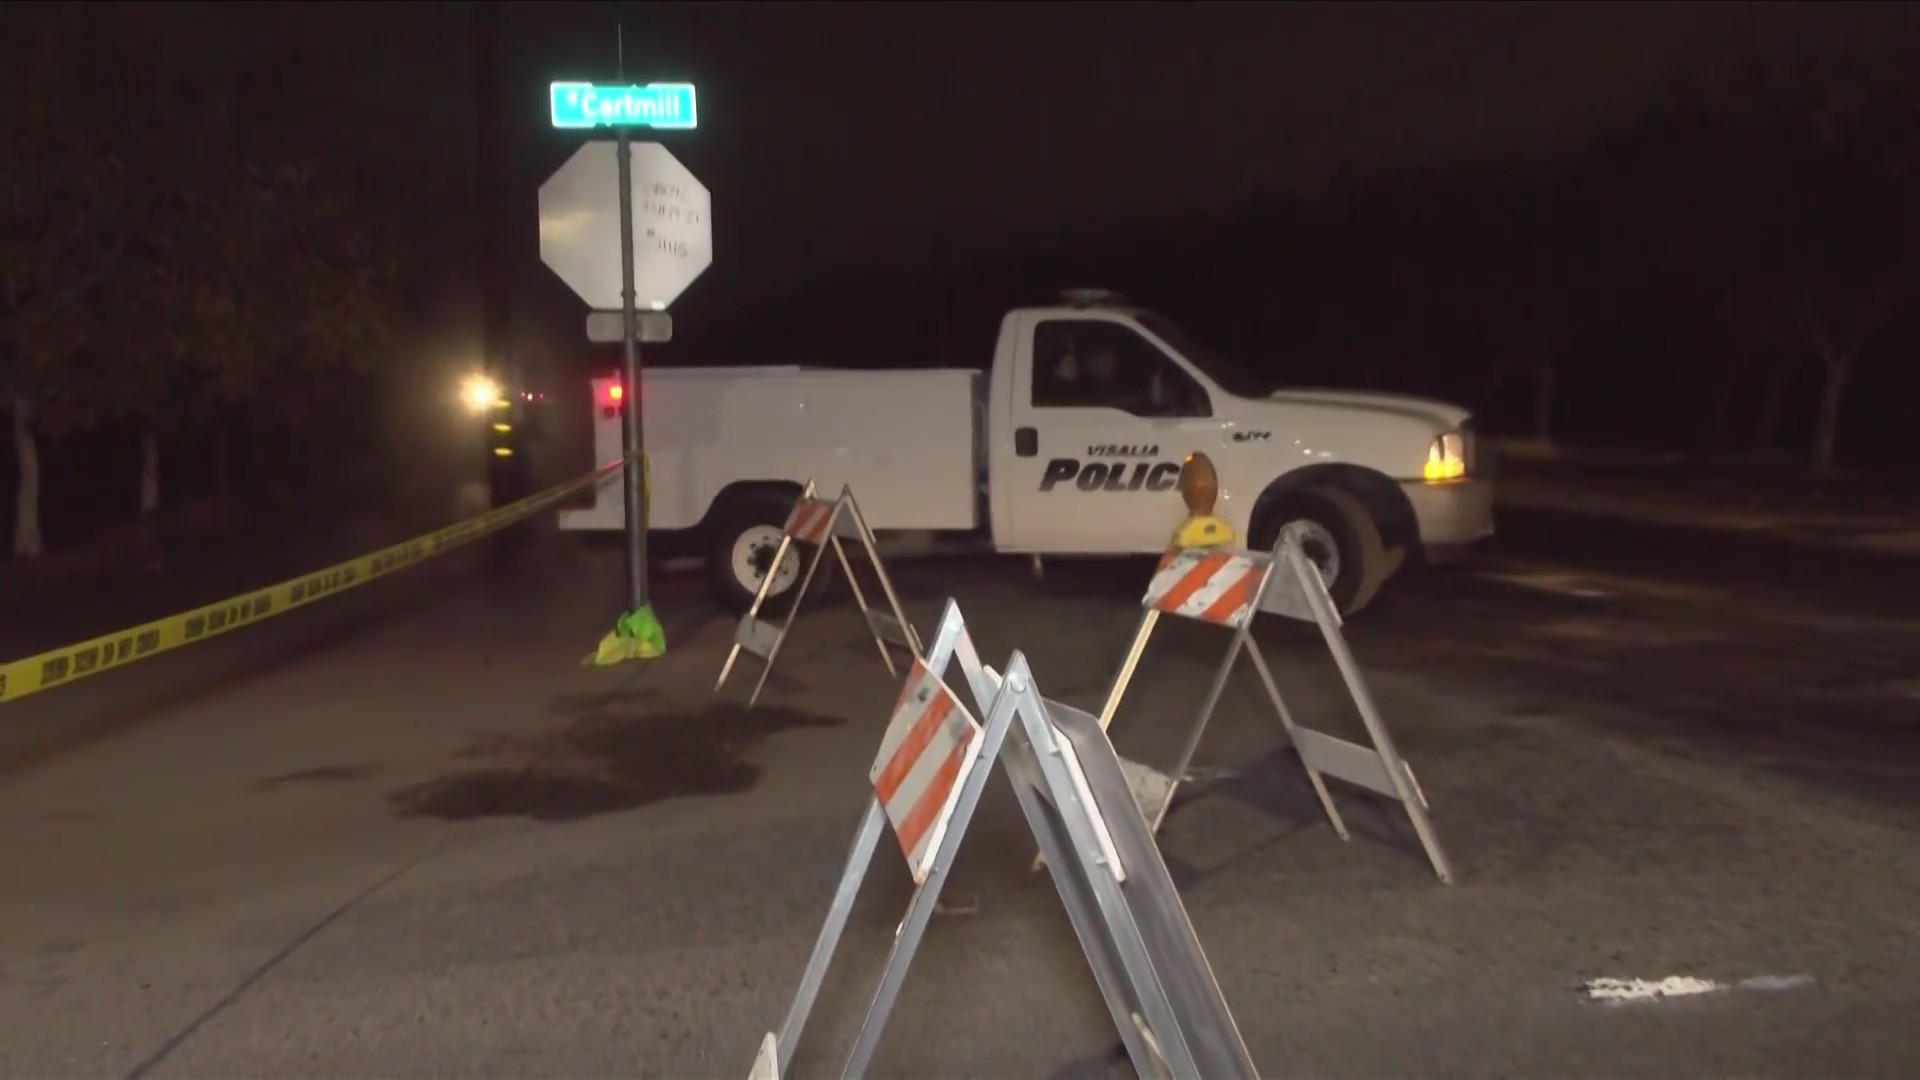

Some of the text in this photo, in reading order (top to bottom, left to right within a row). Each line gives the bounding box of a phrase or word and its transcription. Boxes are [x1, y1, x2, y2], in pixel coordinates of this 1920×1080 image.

[581, 91, 680, 118] Cartmill
[1087, 444, 1159, 457] VISALIA
[1039, 458, 1184, 492] POLIC
